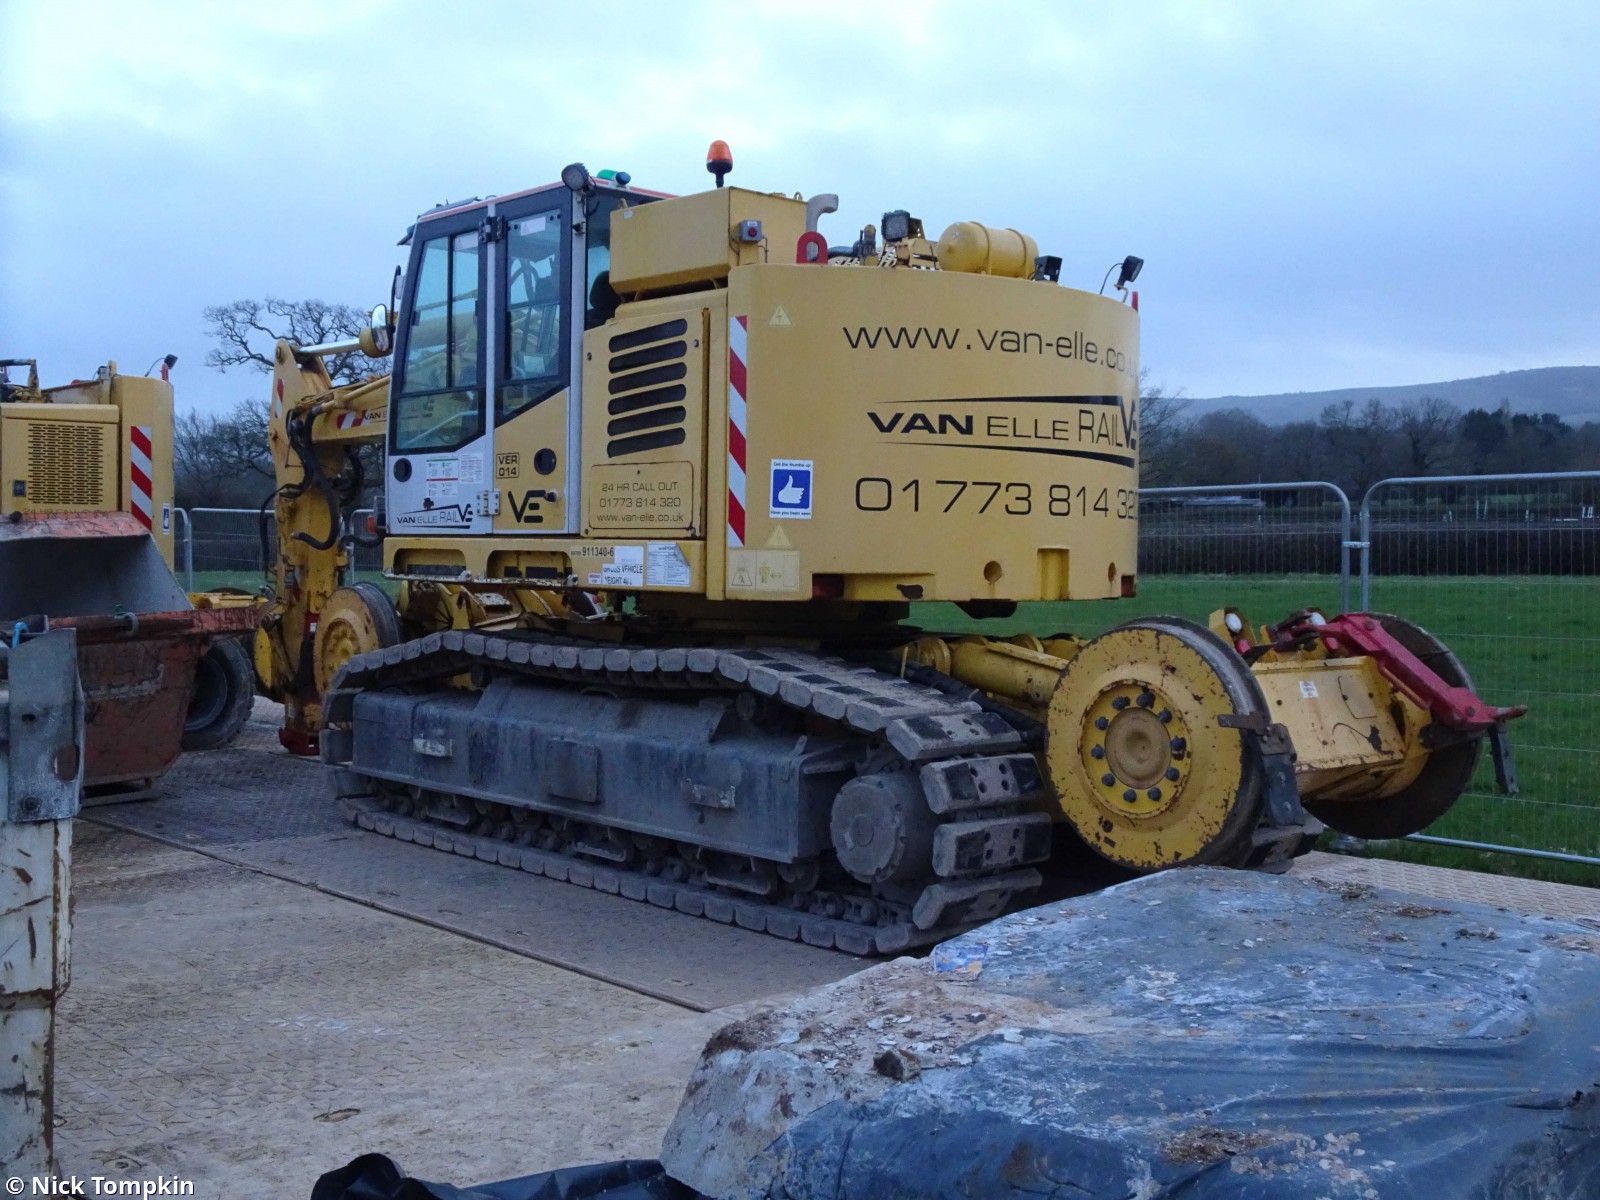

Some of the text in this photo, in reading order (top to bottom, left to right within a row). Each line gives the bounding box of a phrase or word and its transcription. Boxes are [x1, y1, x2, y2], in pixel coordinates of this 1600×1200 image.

[363, 411, 381, 420] VAN
[866, 411, 974, 435] VAN
[987, 416, 1070, 441] ELLE
[498, 455, 518, 465] VER
[498, 467, 517, 477] 014
[601, 481, 678, 492] 24 HR CALL OUT
[600, 497, 681, 507] 01773 814 320
[855, 477, 1032, 515] 01773
[1048, 484, 1109, 518] 814
[396, 516, 416, 524] VAN
[417, 513, 438, 524] ELLE
[439, 511, 459, 523] RAIL
[596, 512, 684, 522] www.van-elle.co.uk
[582, 546, 614, 557] 911340-6
